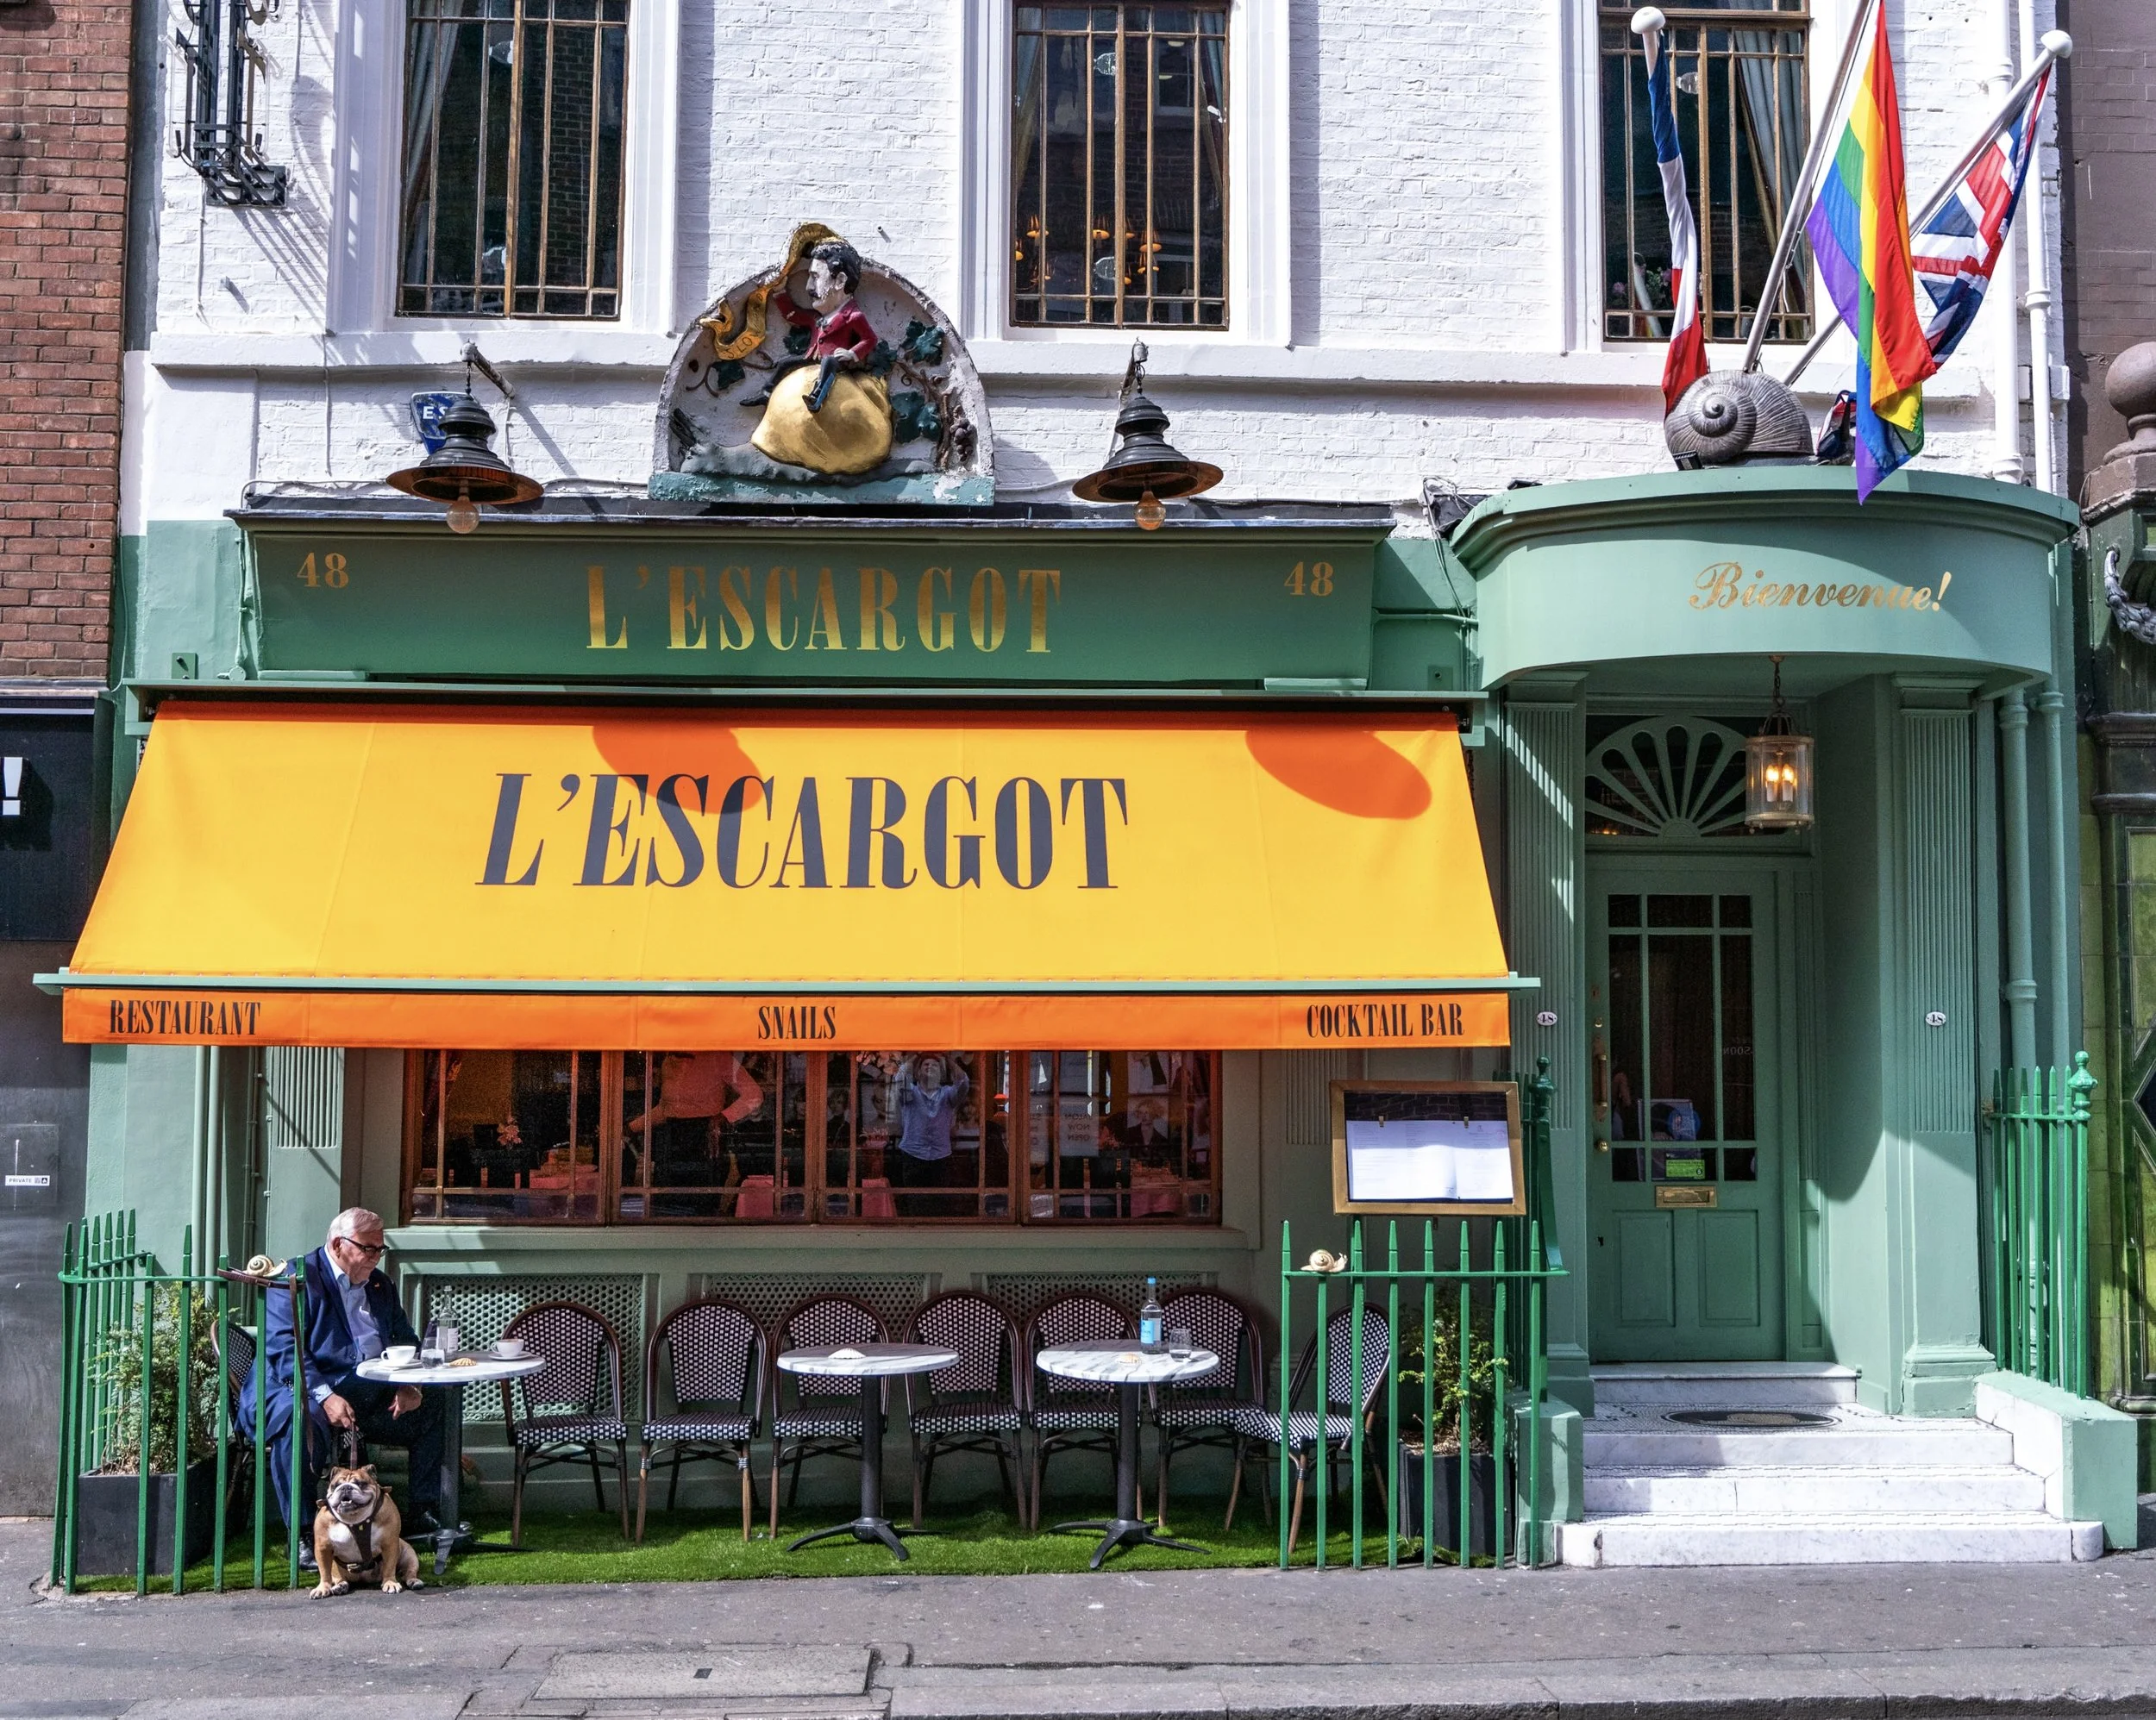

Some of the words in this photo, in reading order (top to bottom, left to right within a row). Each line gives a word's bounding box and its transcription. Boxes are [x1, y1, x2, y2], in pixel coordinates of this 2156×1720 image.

[422, 405, 449, 420] ES
[297, 552, 349, 588] 48
[1283, 561, 1334, 597] 48
[1689, 560, 1952, 611] Bienvenue!
[586, 565, 1062, 654] L'ESCARGOT
[474, 772, 1128, 891] L'ESCARGOT
[110, 999, 261, 1035] RESTAURANT
[758, 1005, 837, 1040] SNAILS
[1307, 1004, 1413, 1038] COCKTAIL
[1420, 1003, 1465, 1036] BAR
[1539, 1013, 1554, 1023] 48
